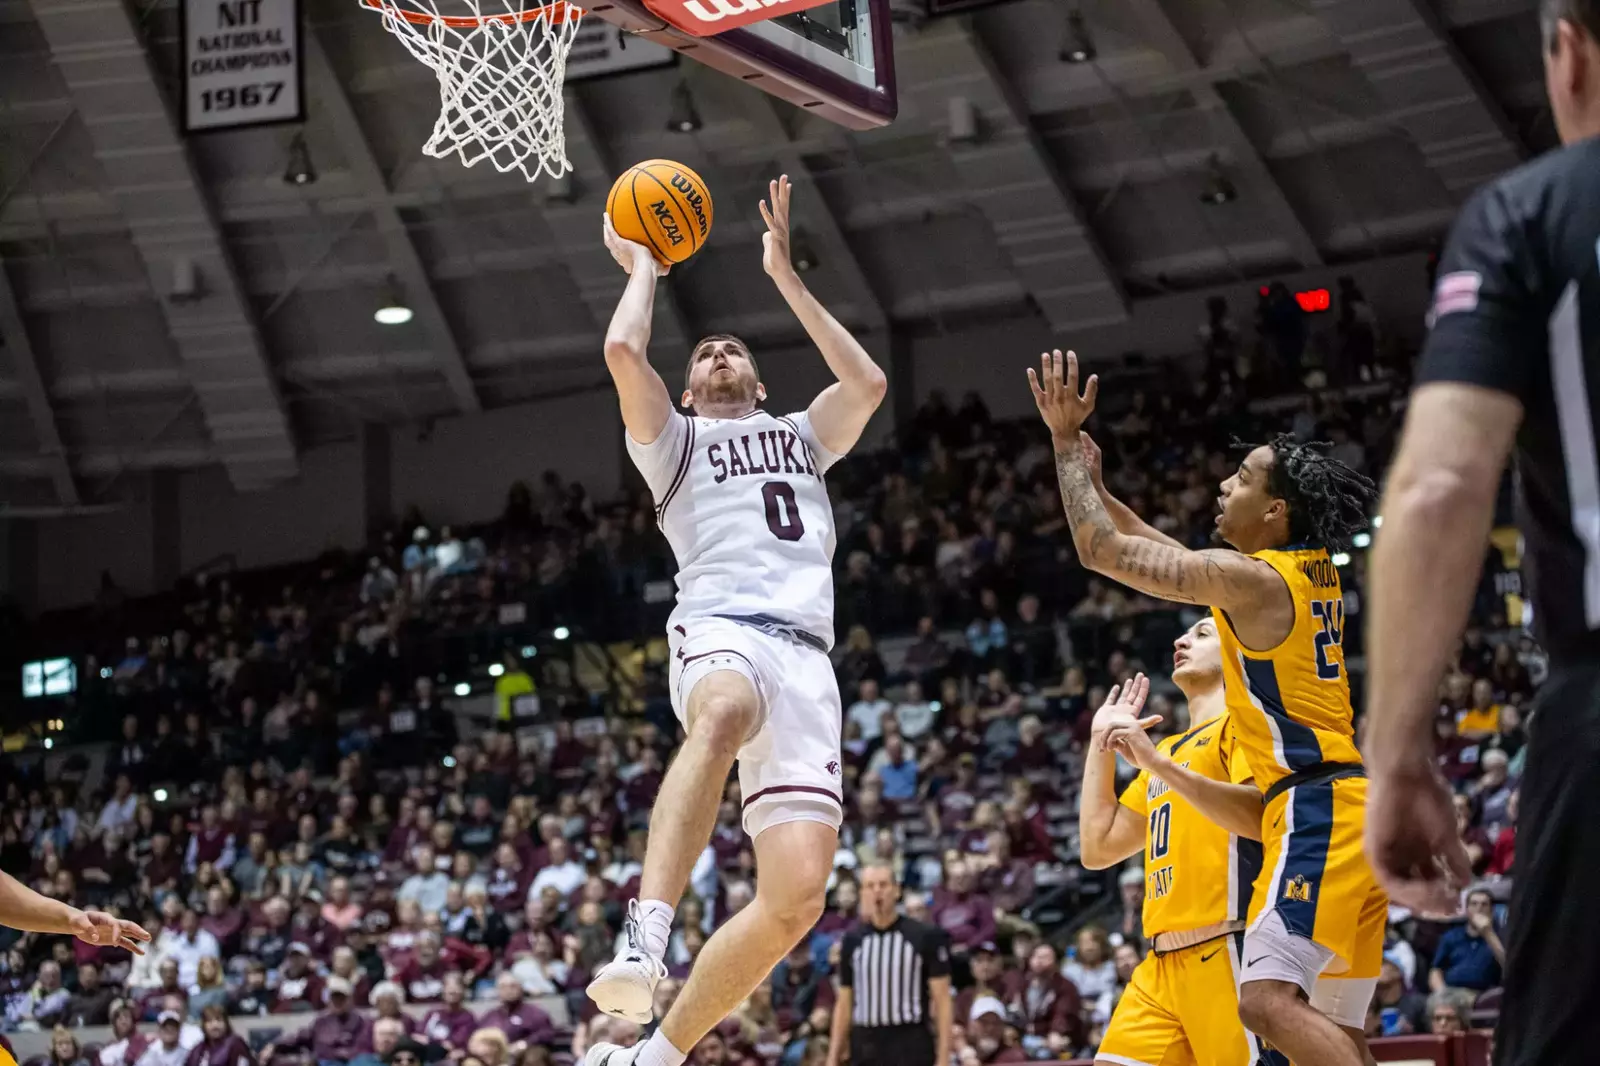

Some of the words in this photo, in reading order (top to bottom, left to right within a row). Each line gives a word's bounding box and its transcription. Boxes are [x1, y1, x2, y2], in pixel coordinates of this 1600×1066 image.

[218, 0, 262, 28] NIT
[191, 48, 292, 77] CHAMPIONS
[198, 28, 283, 52] NATIONAL
[201, 81, 286, 113] 1967
[650, 200, 685, 247] NCAA
[670, 172, 708, 238] Wilson
[761, 481, 805, 542] 0
[1310, 599, 1345, 680] 24
[1149, 802, 1172, 862] 10
